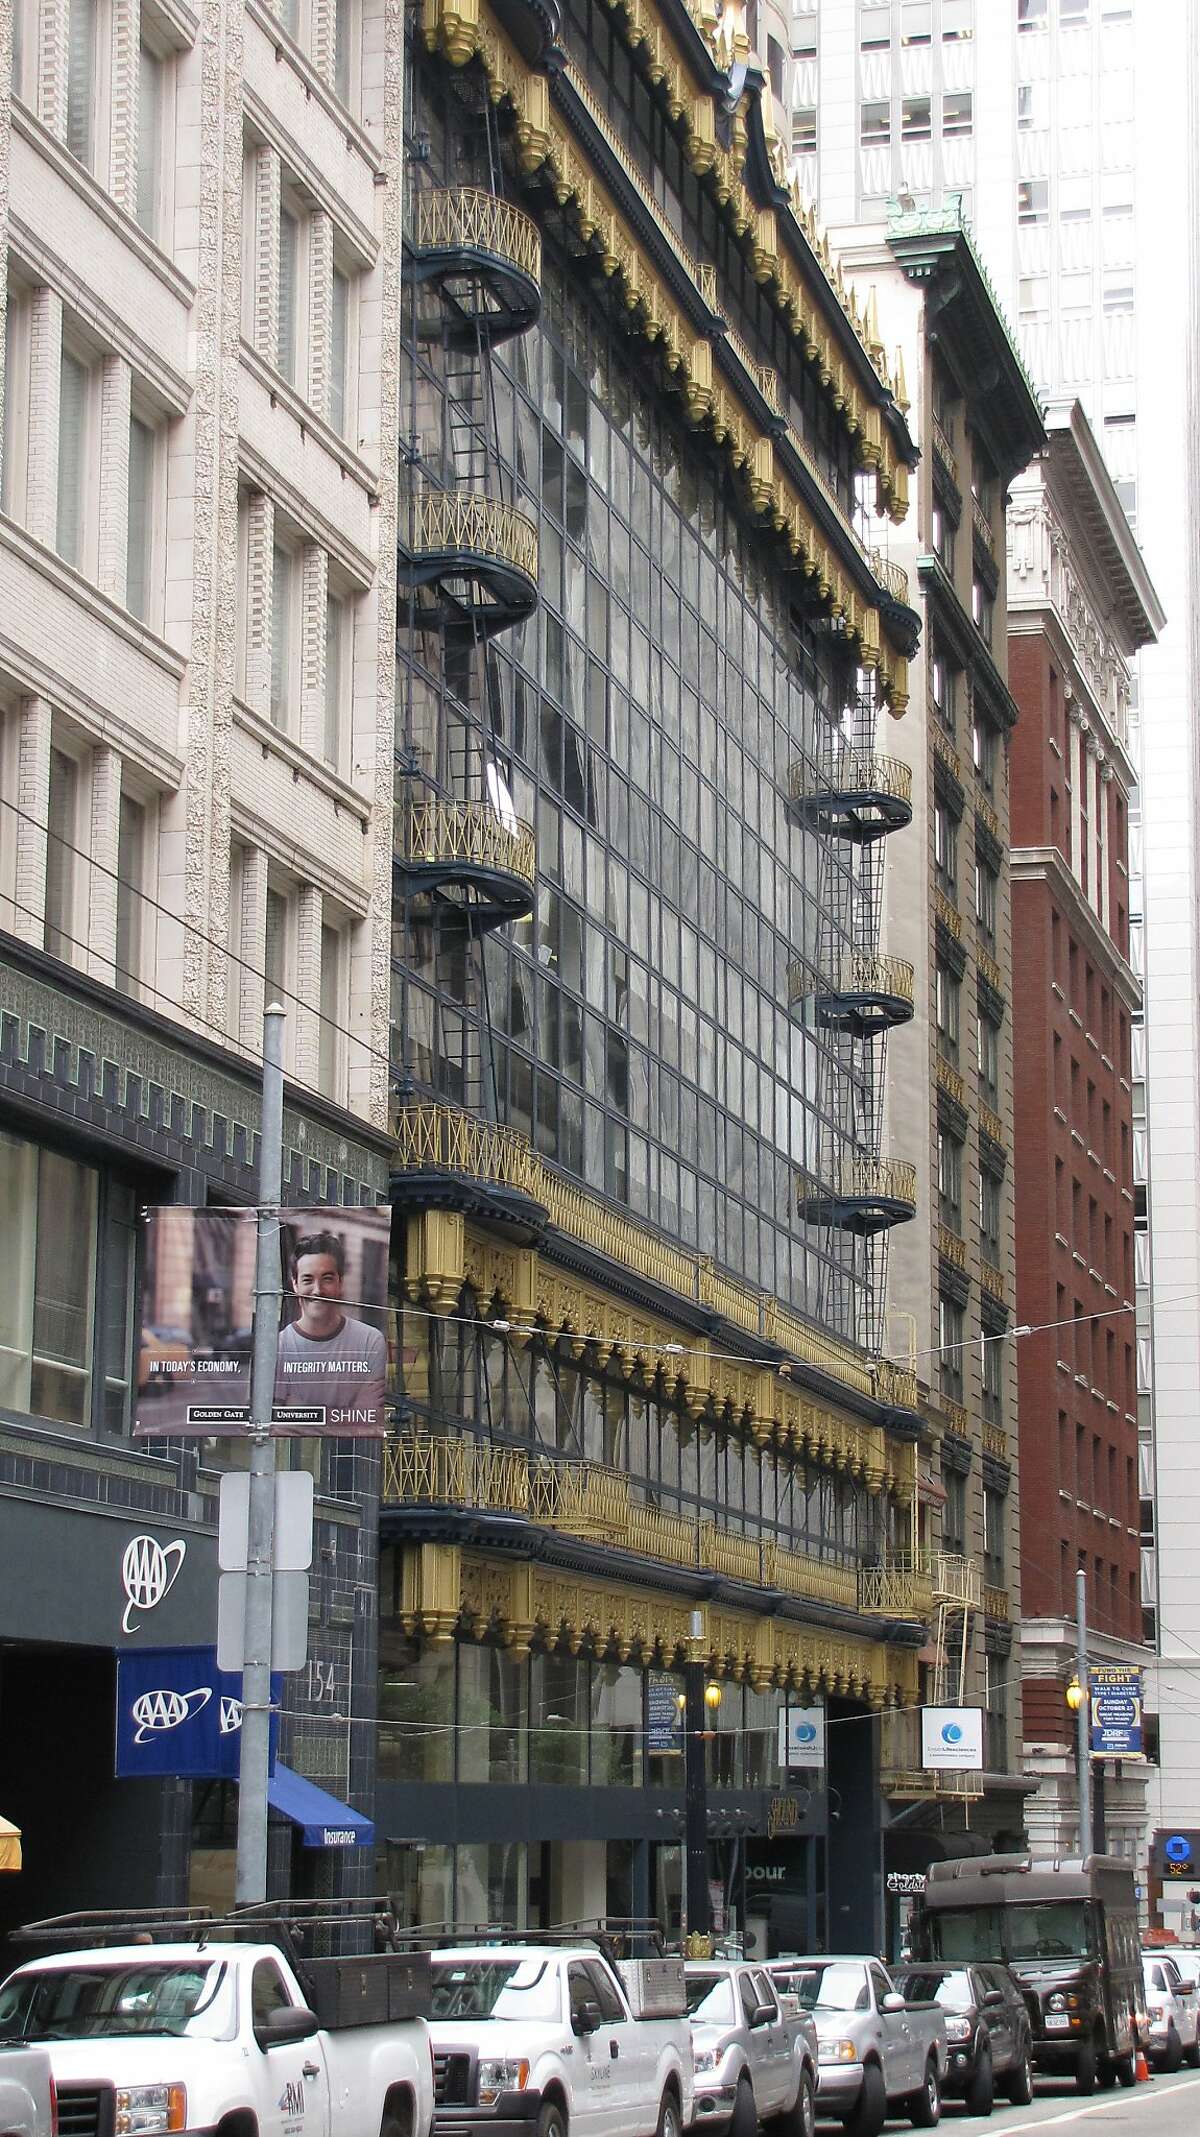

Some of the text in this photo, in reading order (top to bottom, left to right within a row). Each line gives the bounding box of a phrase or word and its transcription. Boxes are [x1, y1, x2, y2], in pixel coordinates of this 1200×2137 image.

[149, 1360, 241, 1374] IN TODAY'S ECONOMY,
[283, 1361, 371, 1373] INTEGRITY MATTERS.
[224, 1410, 244, 1418] GATE
[276, 1411, 319, 1419] UNIVERSITY
[330, 1409, 377, 1423] SHINE
[308, 1659, 335, 1702] 154
[1098, 1674, 1132, 1682] FIGHT
[133, 1690, 189, 1729] AAA
[1102, 1729, 1124, 1737] JDRF
[324, 1827, 356, 1844] Insurance
[887, 1872, 927, 1881] shorty
